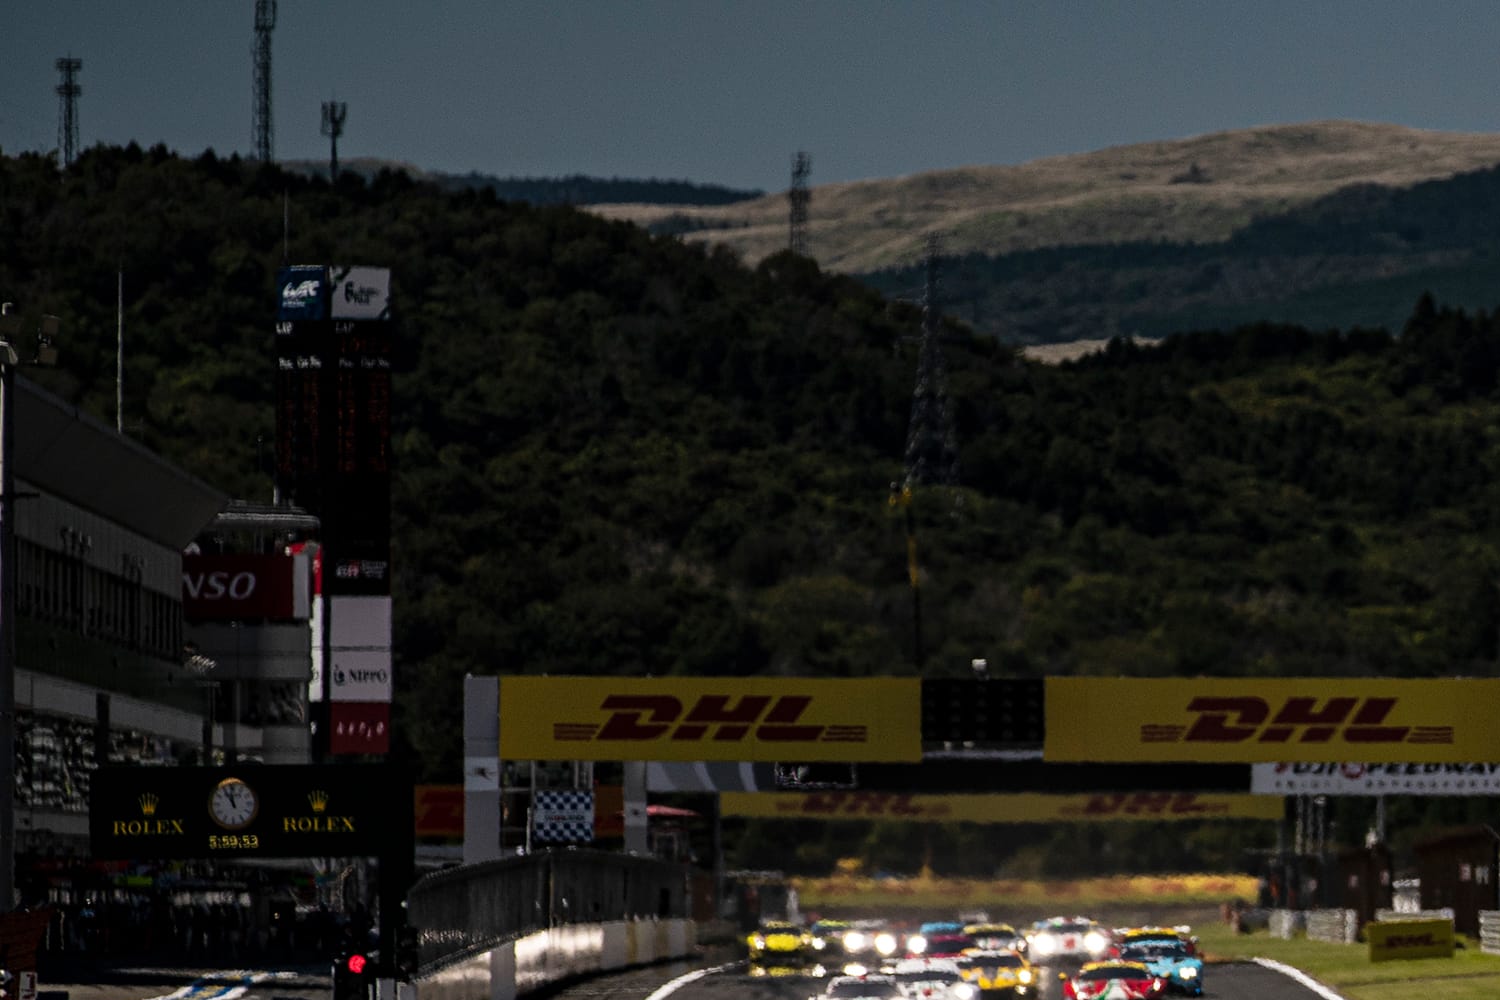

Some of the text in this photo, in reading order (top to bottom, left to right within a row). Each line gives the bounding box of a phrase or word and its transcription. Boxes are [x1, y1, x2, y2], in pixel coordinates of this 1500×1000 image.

[350, 668, 388, 684] NIPPO
[596, 694, 826, 741] DHL
[1185, 696, 1411, 743] DHL
[112, 818, 185, 836] ROLEX
[282, 815, 357, 833] ROLEX
[208, 834, 260, 850] 5:59:53
